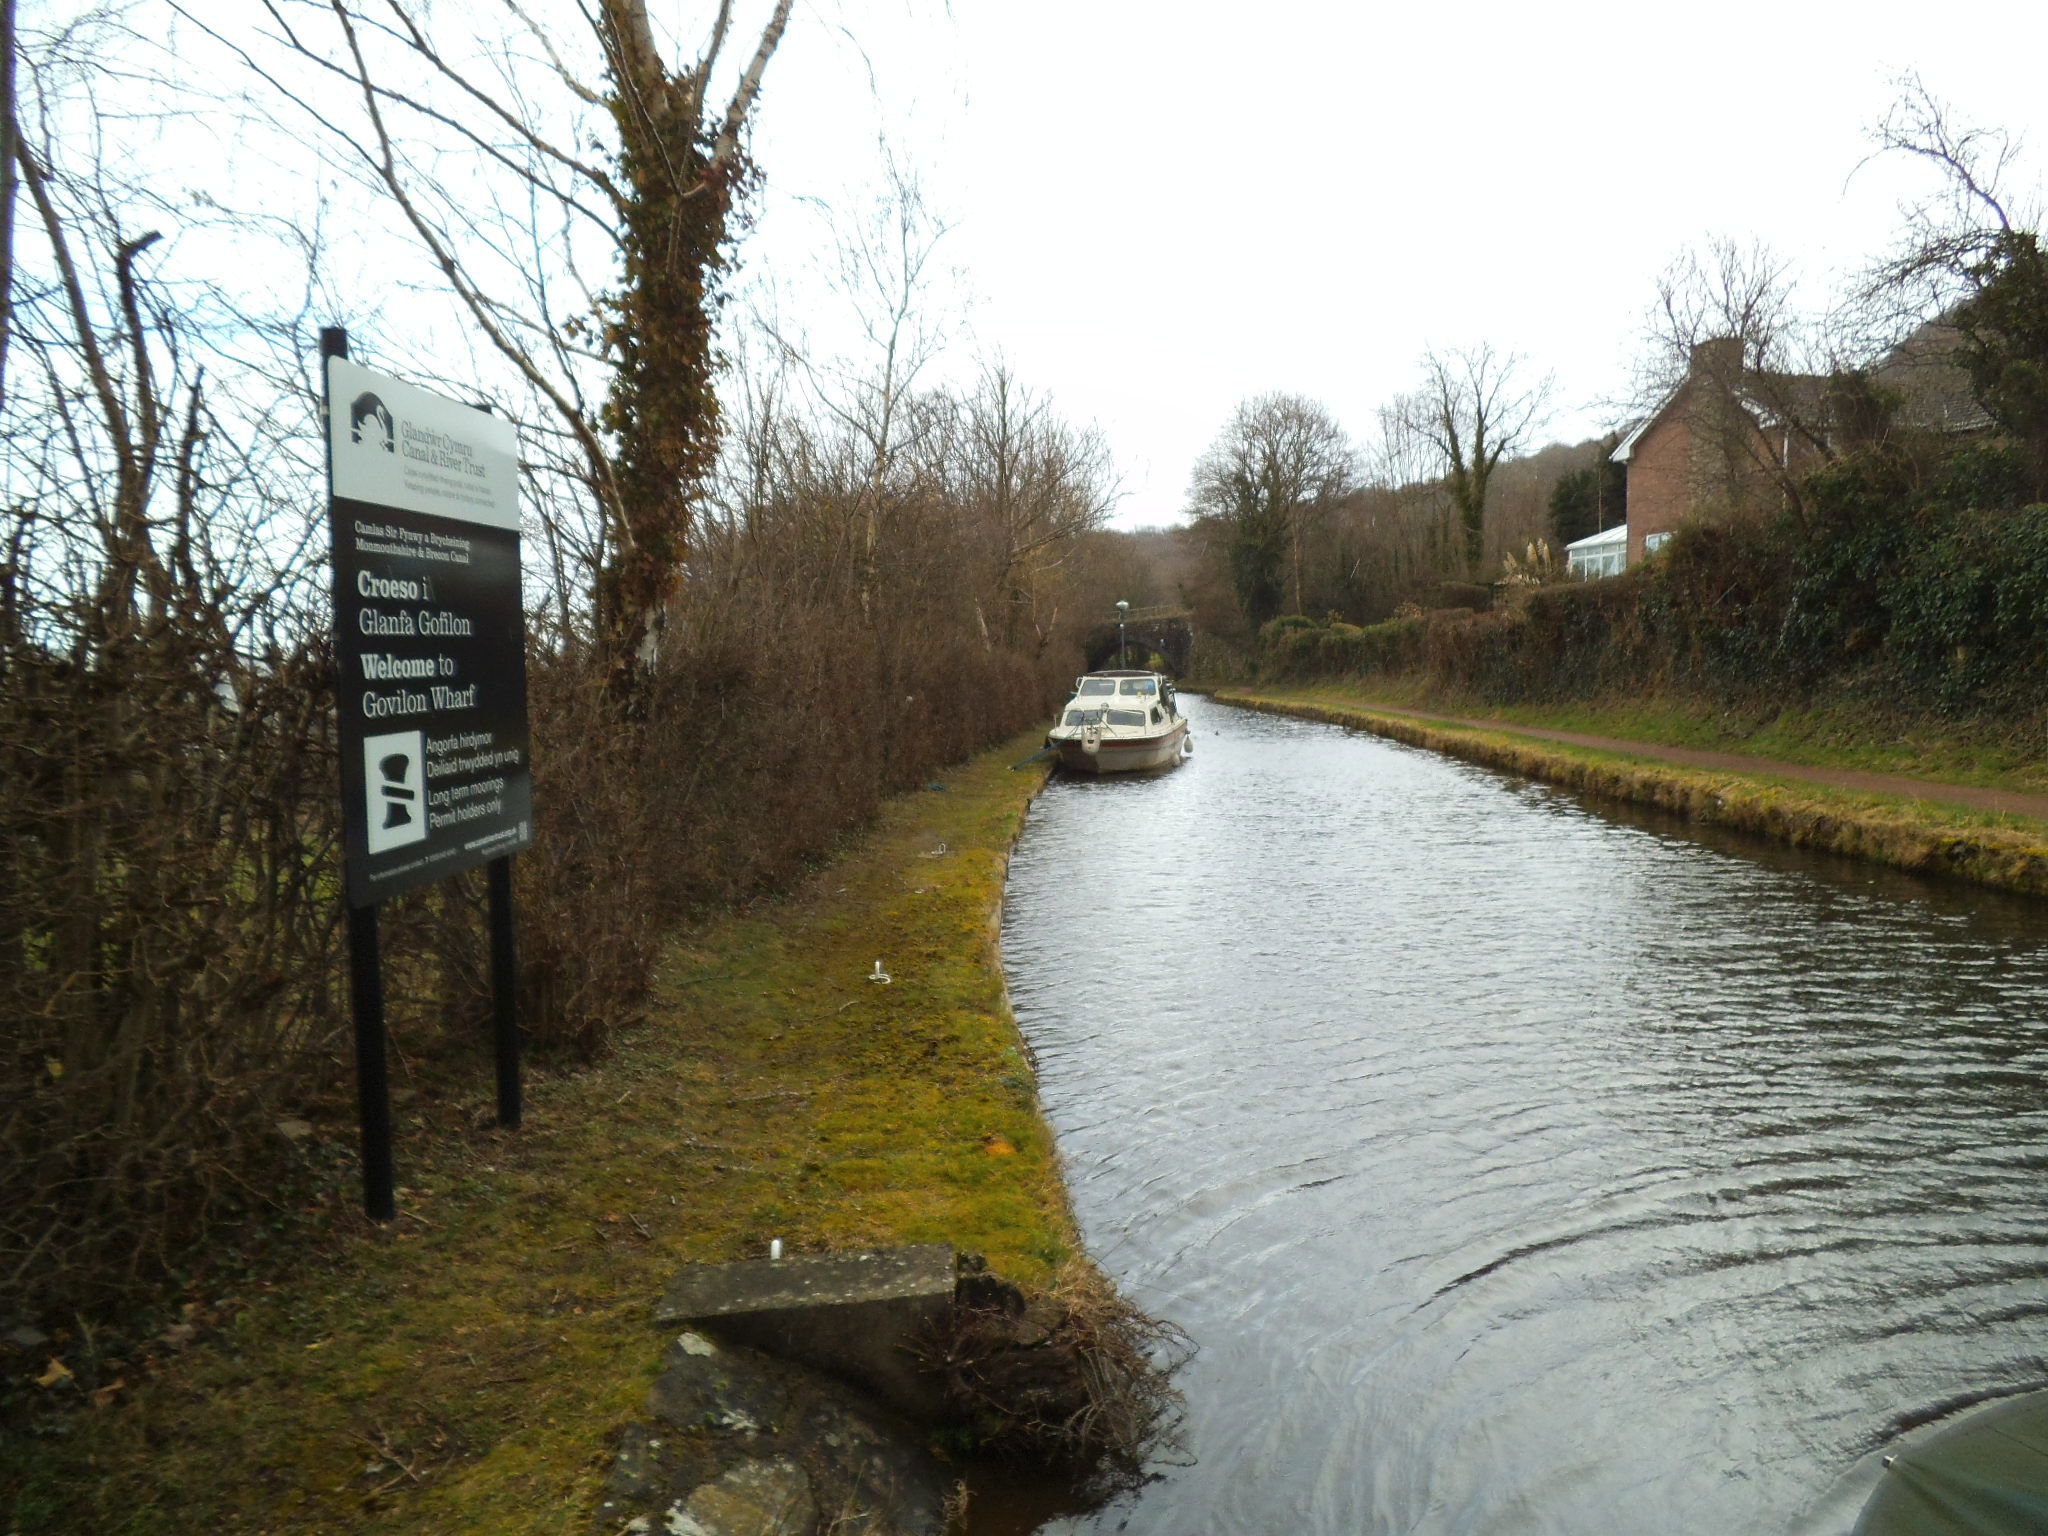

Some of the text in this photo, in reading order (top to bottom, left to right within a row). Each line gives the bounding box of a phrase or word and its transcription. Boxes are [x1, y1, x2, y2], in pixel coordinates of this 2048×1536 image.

[402, 440, 430, 463] Canal
[440, 451, 462, 471] River
[463, 457, 486, 478] Trust
[443, 433, 473, 457] Cymru
[354, 520, 384, 536] Camlas
[355, 537, 417, 557] Monmouthshire
[450, 550, 469, 563] Canal
[358, 570, 417, 600] Croeso
[359, 607, 472, 636] Glanfa Gofilon
[360, 653, 454, 680] Welcome to
[362, 684, 476, 718] Govilon Wharf
[428, 777, 505, 807] Long term moorings
[429, 796, 502, 829] Permit holders only
